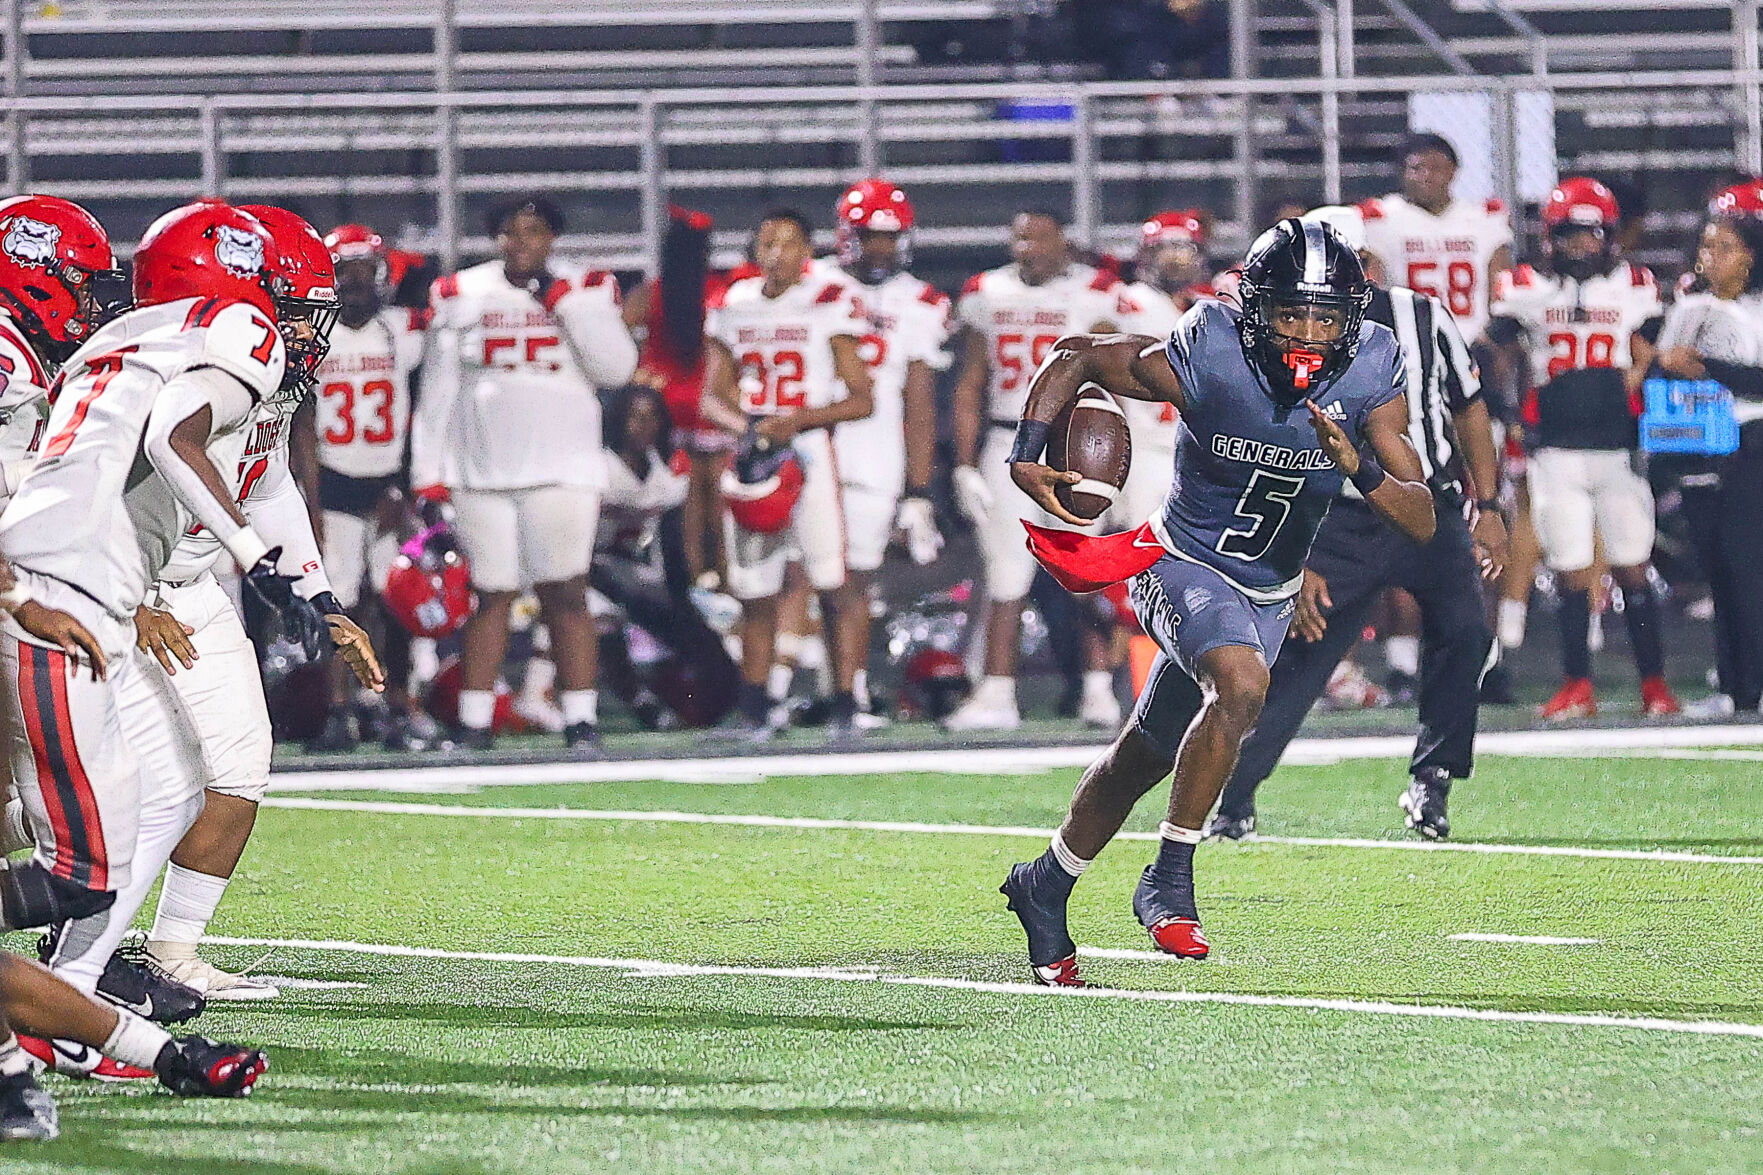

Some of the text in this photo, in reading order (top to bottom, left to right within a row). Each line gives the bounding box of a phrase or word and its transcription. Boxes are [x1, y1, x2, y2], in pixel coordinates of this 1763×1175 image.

[1296, 281, 1332, 293] Riddell
[323, 381, 395, 444] 33
[1215, 468, 1306, 562] 5
